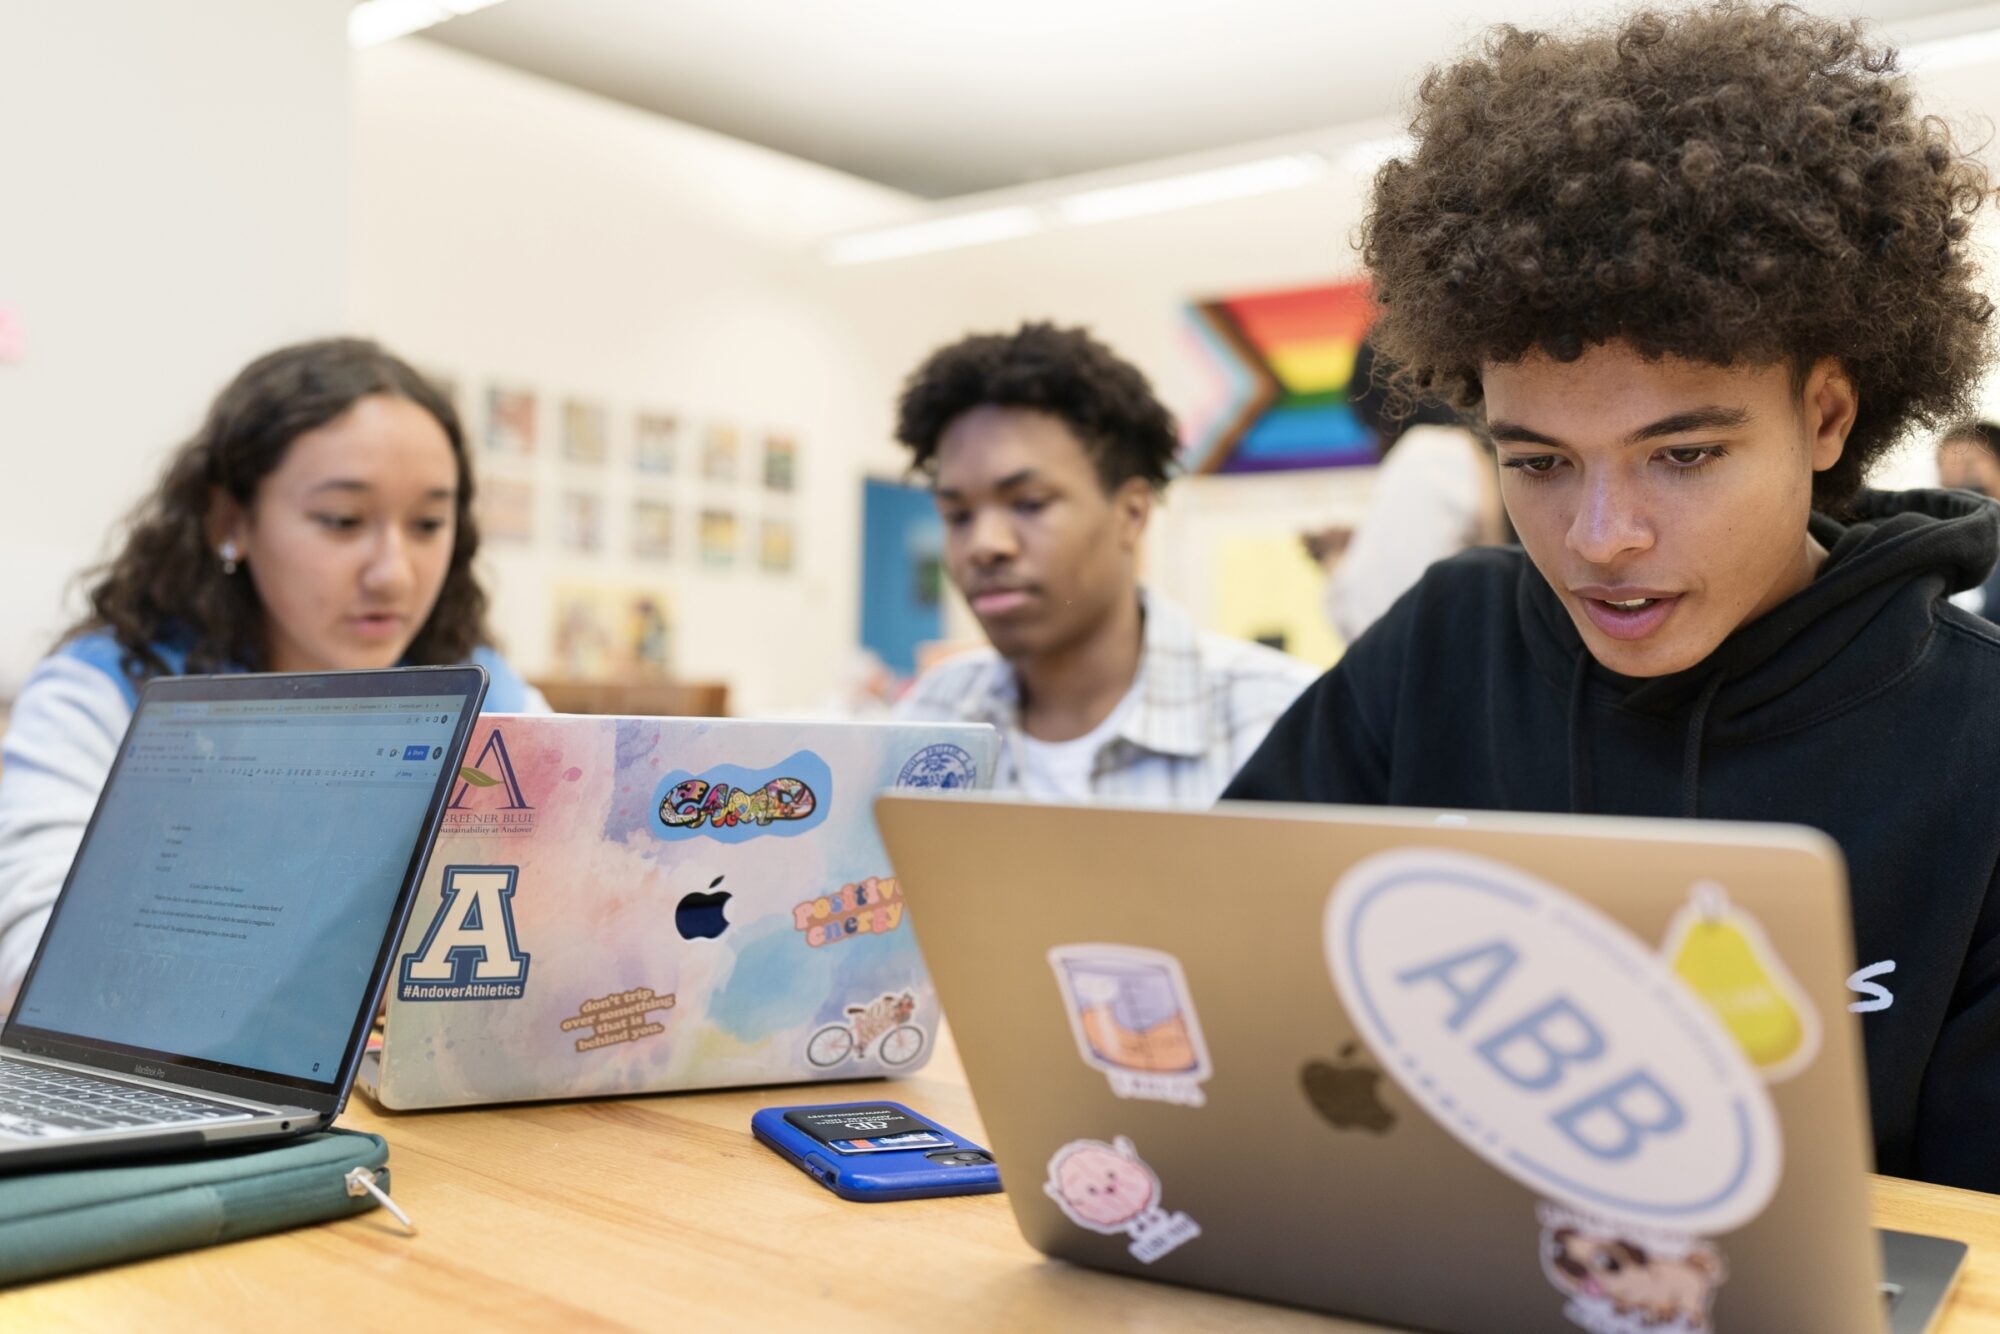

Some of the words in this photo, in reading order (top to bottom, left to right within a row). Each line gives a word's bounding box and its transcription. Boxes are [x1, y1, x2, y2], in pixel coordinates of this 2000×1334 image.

[659, 777, 816, 828] CAMP
[441, 813, 499, 823] GREENER
[503, 813, 535, 823] BLUE
[795, 878, 903, 929] positiv
[404, 868, 528, 982] A
[403, 984, 521, 998] #AndoverAthletics
[582, 995, 620, 1013] don't
[624, 989, 652, 1003] trip
[562, 1015, 596, 1030] over
[599, 996, 674, 1020] something
[596, 1019, 628, 1034] that
[630, 1014, 643, 1025] is
[579, 1030, 628, 1051] behind
[1397, 940, 1687, 1163] ABB
